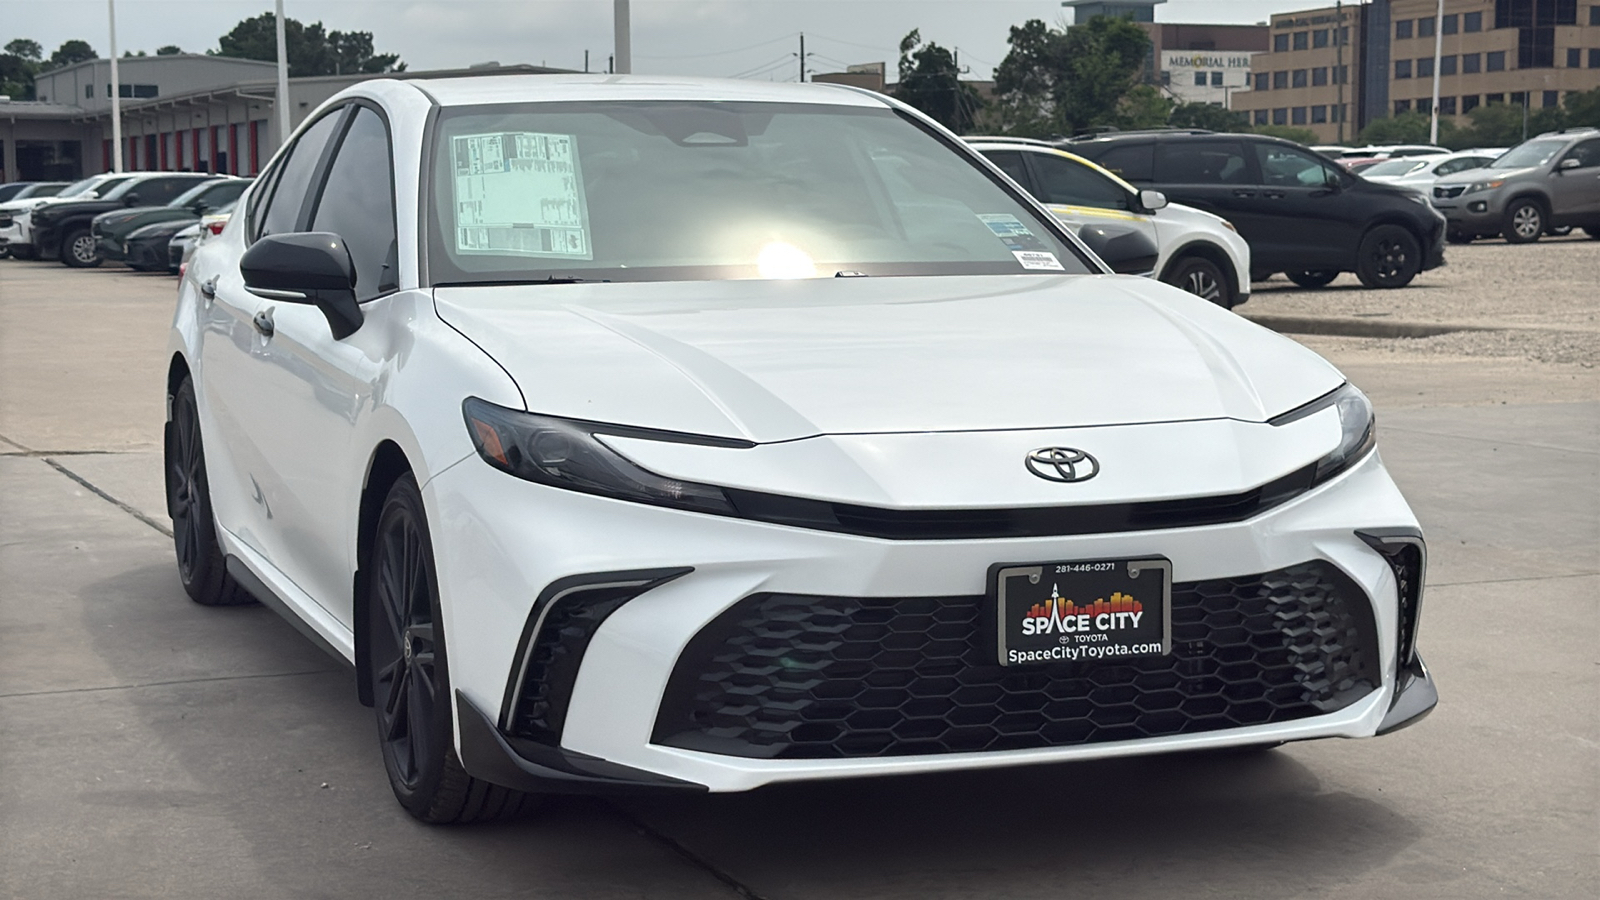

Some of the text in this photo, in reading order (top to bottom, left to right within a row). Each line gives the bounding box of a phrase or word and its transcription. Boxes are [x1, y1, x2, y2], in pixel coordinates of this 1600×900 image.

[1169, 55, 1225, 68] MEMORIAL
[1055, 563, 1115, 573] 281-446-0271
[1022, 605, 1143, 635] SPACE CITY
[1074, 633, 1109, 643] TOYOTA
[1009, 642, 1162, 663] SpaceCityToyota.com
